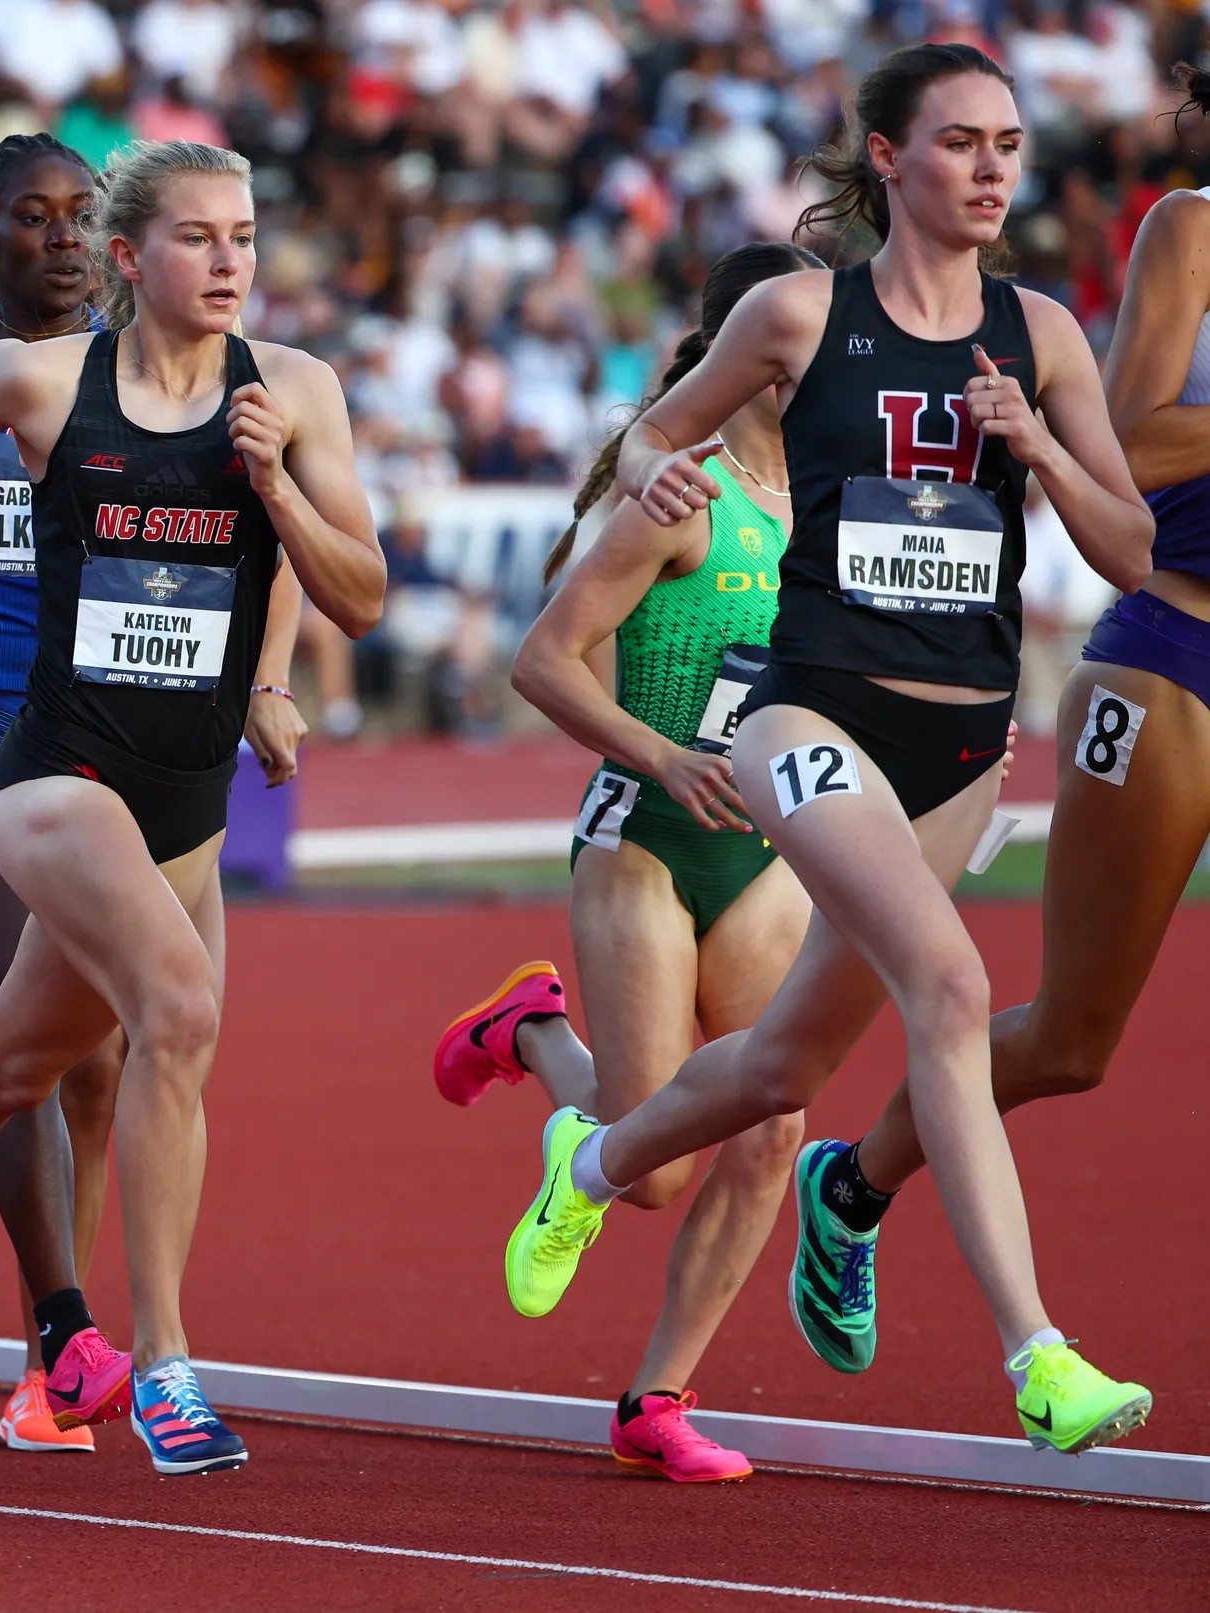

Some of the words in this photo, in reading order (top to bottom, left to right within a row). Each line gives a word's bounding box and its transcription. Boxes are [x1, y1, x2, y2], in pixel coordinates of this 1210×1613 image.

[848, 338, 875, 350] IVY
[878, 390, 985, 484] H
[86, 454, 127, 469] ACC
[95, 503, 141, 540] NC
[142, 507, 239, 545] STATE
[901, 534, 946, 554] MAIA
[26, 563, 36, 572] TX
[848, 554, 991, 594] RAMSDEN
[872, 596, 902, 609] AUSTIN,
[904, 600, 916, 609] TX
[929, 602, 950, 612] JUNE
[123, 611, 192, 634] KATELYN
[110, 633, 201, 669] TUOHY
[105, 672, 136, 684] AUSTIN,
[138, 675, 149, 685] TX
[161, 678, 182, 688] JUNE
[1085, 697, 1130, 774] 8
[776, 746, 849, 805] 12
[585, 777, 627, 838] 7
